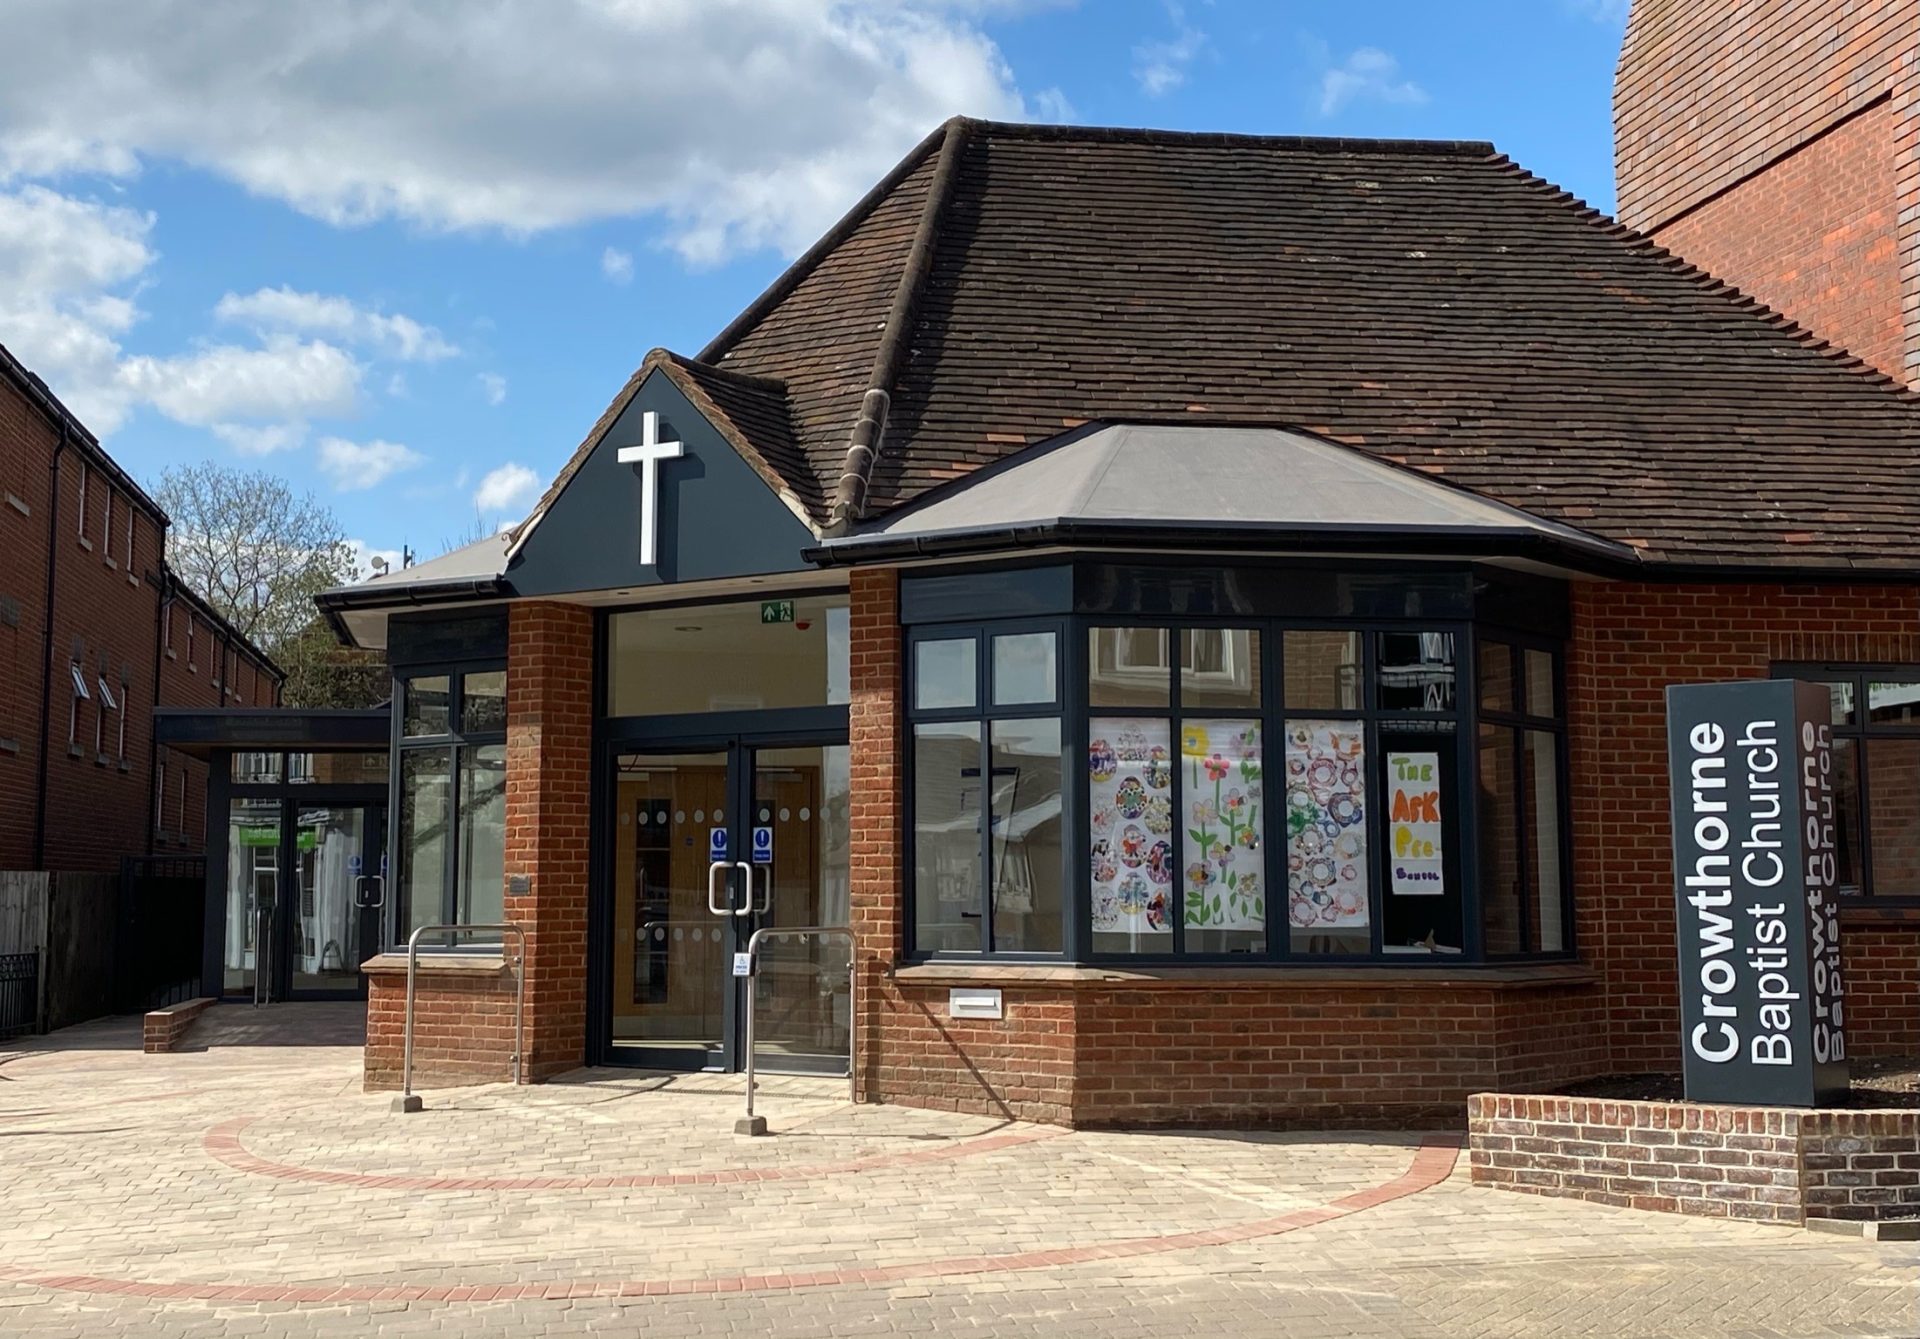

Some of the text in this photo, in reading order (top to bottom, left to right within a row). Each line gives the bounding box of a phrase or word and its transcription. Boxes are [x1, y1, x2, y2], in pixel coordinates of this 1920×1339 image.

[1685, 722, 1740, 1063] Crowthorne
[1736, 720, 1800, 1065] Baptist Church
[1802, 721, 1830, 1064] Crowthorne
[1816, 724, 1845, 1062] Baptist Church
